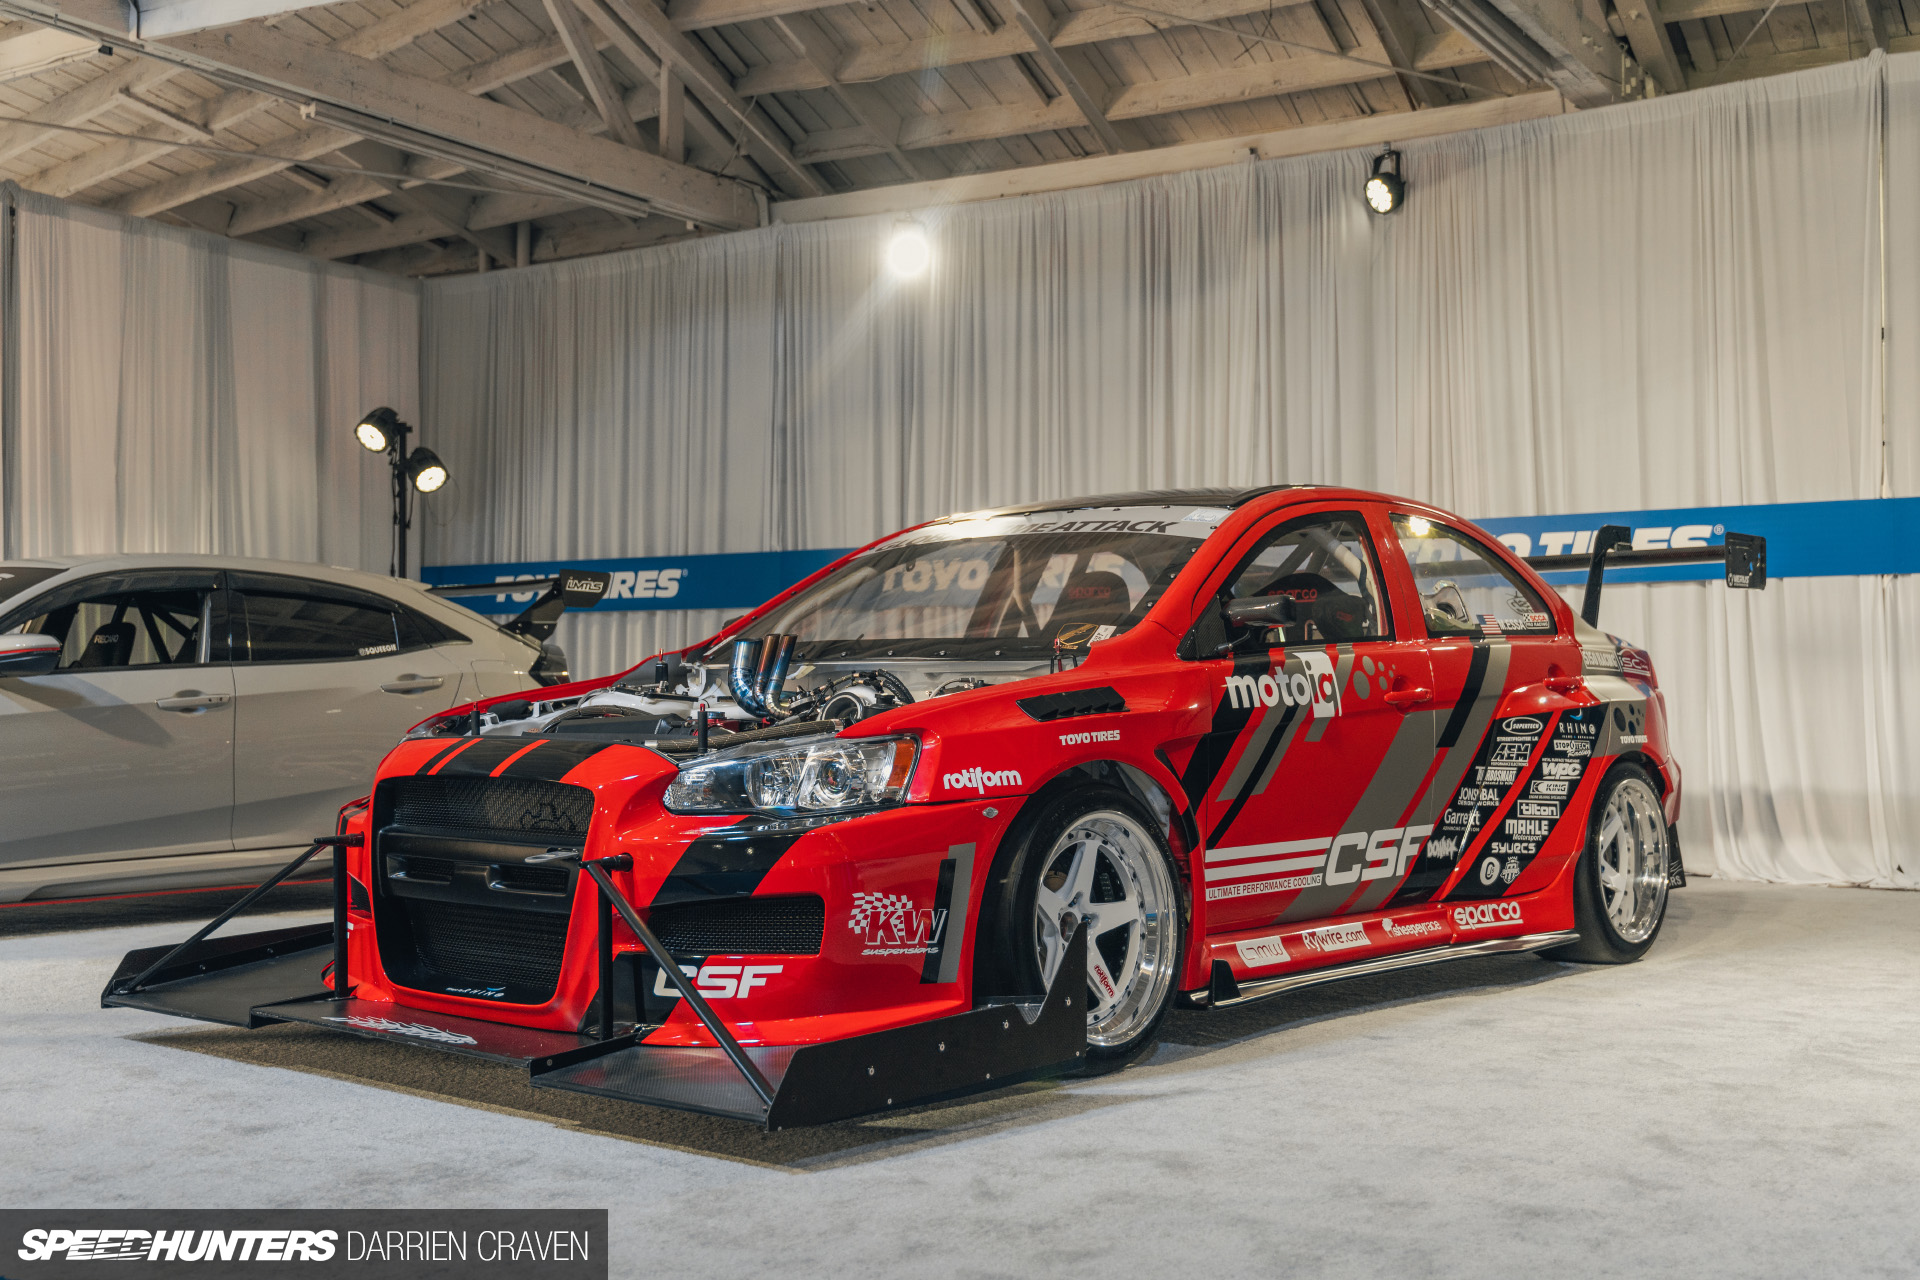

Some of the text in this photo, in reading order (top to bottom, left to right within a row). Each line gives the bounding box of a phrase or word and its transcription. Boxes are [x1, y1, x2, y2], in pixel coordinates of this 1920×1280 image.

[1052, 521, 1179, 533] ATTACK
[1059, 730, 1120, 745] TOYO TIRES
[1620, 735, 1648, 744] TOYO TIRES
[1491, 743, 1530, 762] AEM
[943, 767, 1022, 795] rotiform
[1546, 784, 1566, 792] KING
[1521, 803, 1557, 816] tilton
[1505, 819, 1549, 835] MAHLE
[1325, 824, 1434, 886] CSF
[1208, 875, 1321, 899] ULTIMATE PERFORMANCE COOLING
[1454, 901, 1521, 930] sparco
[865, 908, 948, 945] KW
[1393, 920, 1442, 937] sheepeyrace
[1302, 929, 1367, 952] Rywire.com
[861, 945, 939, 956] suspensions
[653, 965, 783, 999] CSF
[1093, 964, 1115, 998] rotiform
